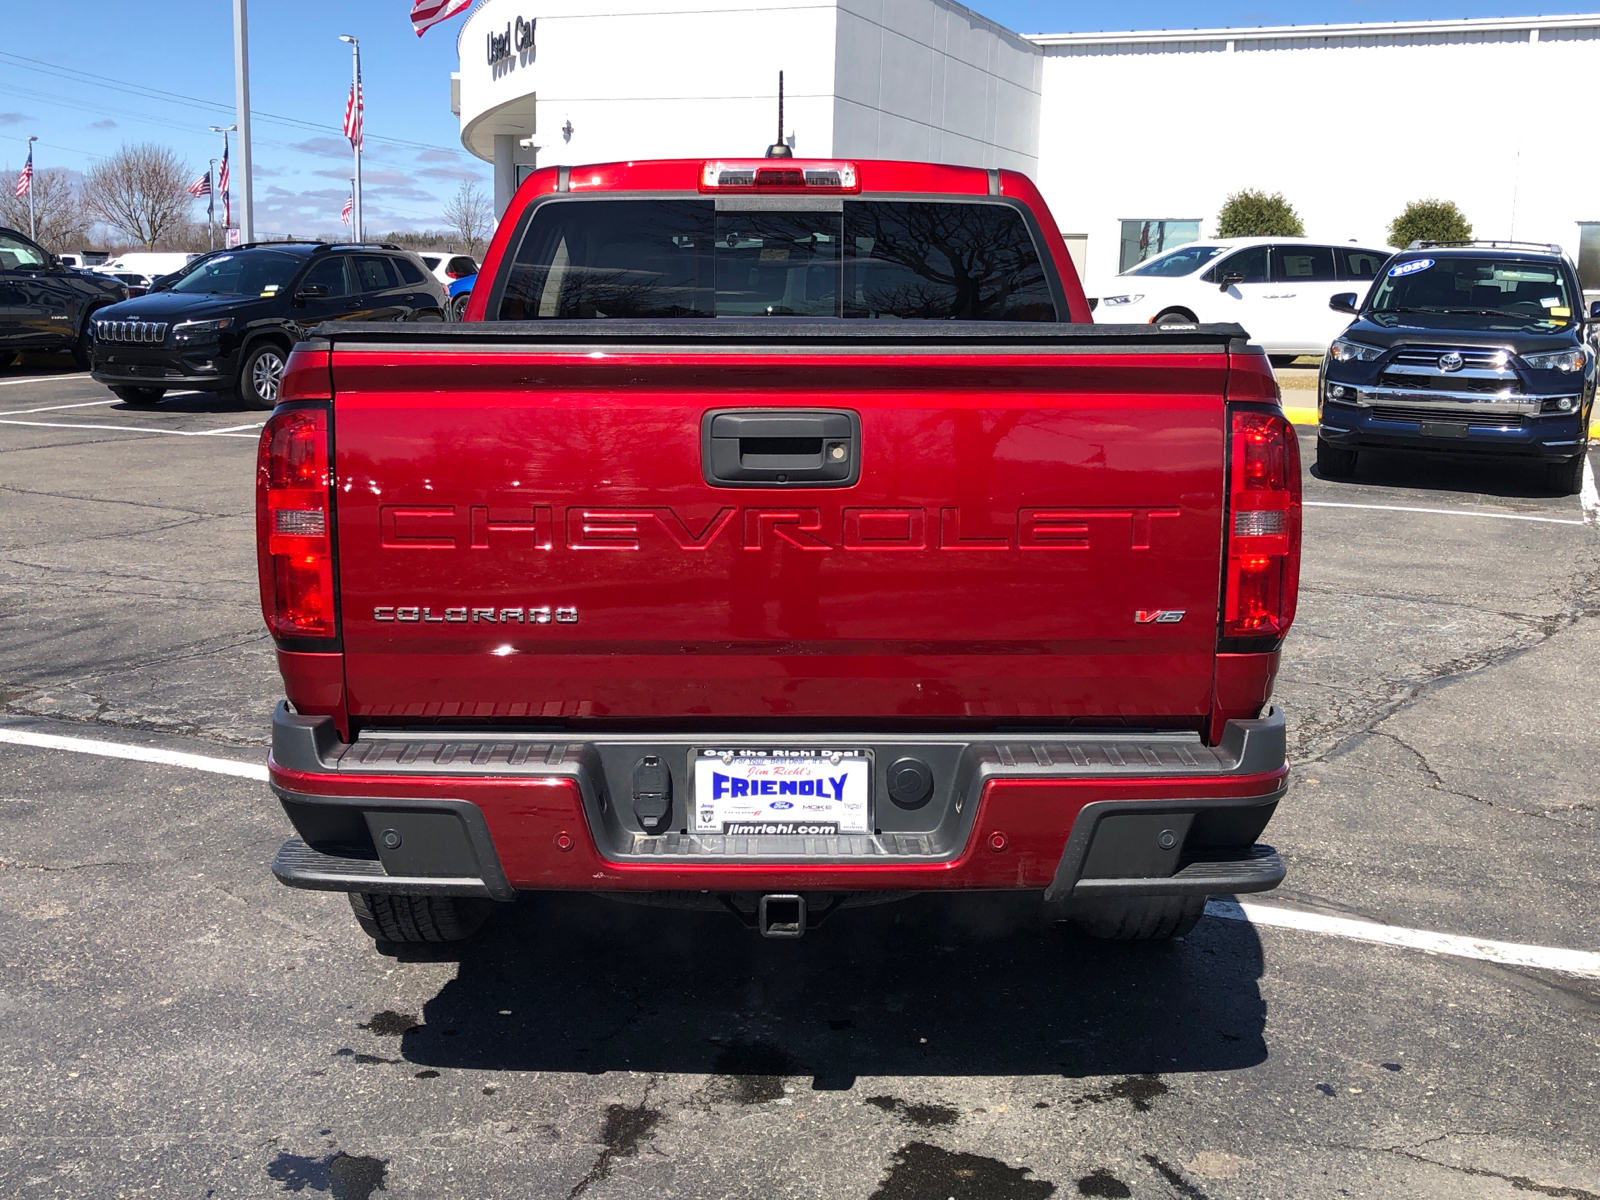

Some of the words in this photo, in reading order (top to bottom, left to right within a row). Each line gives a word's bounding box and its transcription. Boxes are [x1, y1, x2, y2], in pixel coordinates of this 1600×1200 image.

[487, 21, 511, 66] Used
[515, 15, 536, 52] Car
[1393, 260, 1430, 276] 2020
[379, 504, 1181, 551] CHEVROLET
[373, 606, 579, 623] COLORADO
[1135, 610, 1186, 623] V6
[703, 749, 734, 757] Get
[739, 749, 767, 757] the
[772, 749, 816, 757] Riehl
[821, 749, 859, 757] Deal
[746, 766, 769, 778] Jim
[773, 766, 812, 776] Riehl's
[713, 771, 849, 801] FRIENDLY
[773, 801, 790, 810] Ford
[727, 823, 836, 836] jimriehl.com
